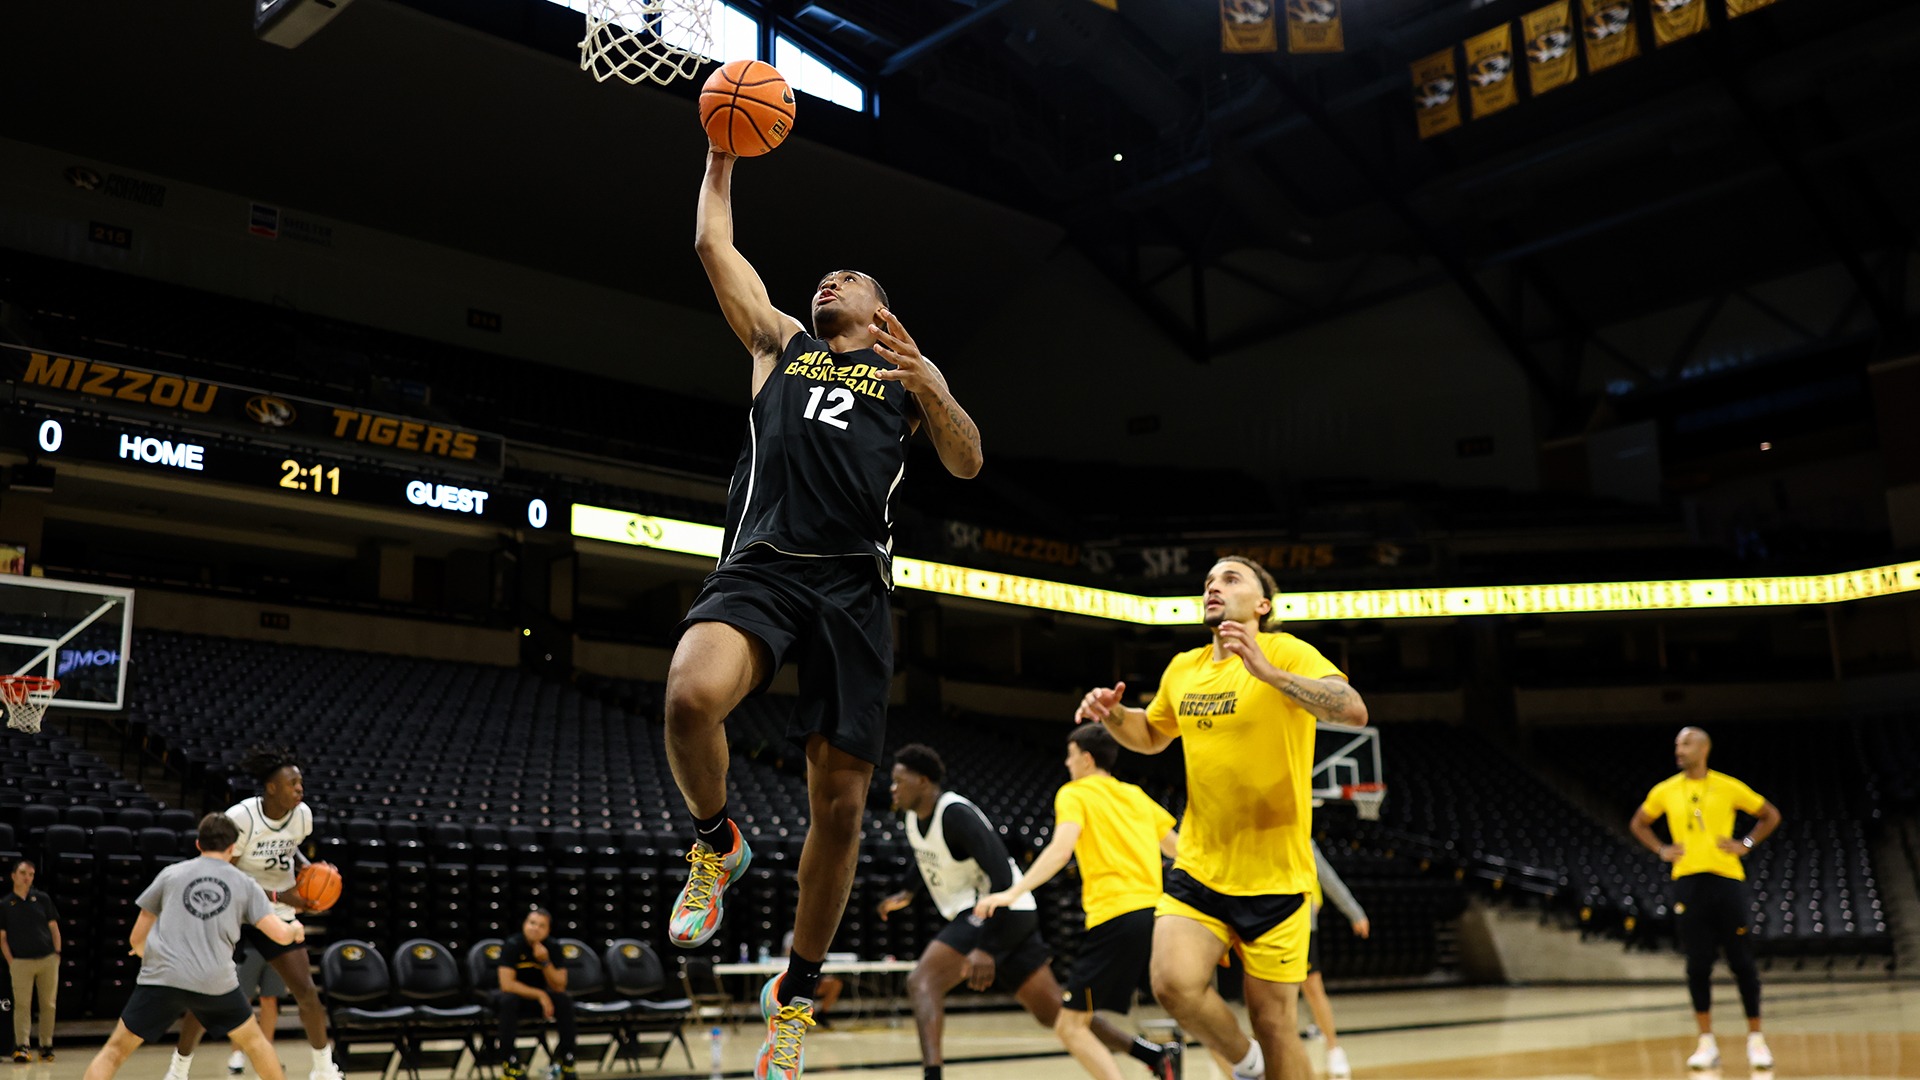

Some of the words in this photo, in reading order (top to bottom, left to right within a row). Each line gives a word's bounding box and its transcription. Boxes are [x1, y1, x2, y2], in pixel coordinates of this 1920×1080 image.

[783, 361, 886, 401] BASKEBALL
[22, 352, 220, 414] MIZZOU
[331, 407, 481, 461] TIGERS
[802, 385, 856, 431] 12
[37, 419, 64, 453] 0
[118, 433, 205, 472] HOME
[277, 458, 342, 497] 2:11
[404, 479, 490, 516] GUEST
[526, 498, 549, 530] 0
[982, 526, 1082, 568] MIZZOU
[1307, 589, 1449, 617] DISCIPLINE
[1484, 581, 1691, 613] UNSELFISHNESS
[1727, 565, 1900, 605] ENTHUSIASM
[1179, 698, 1239, 717] DISCIPLINE
[264, 854, 291, 872] 25
